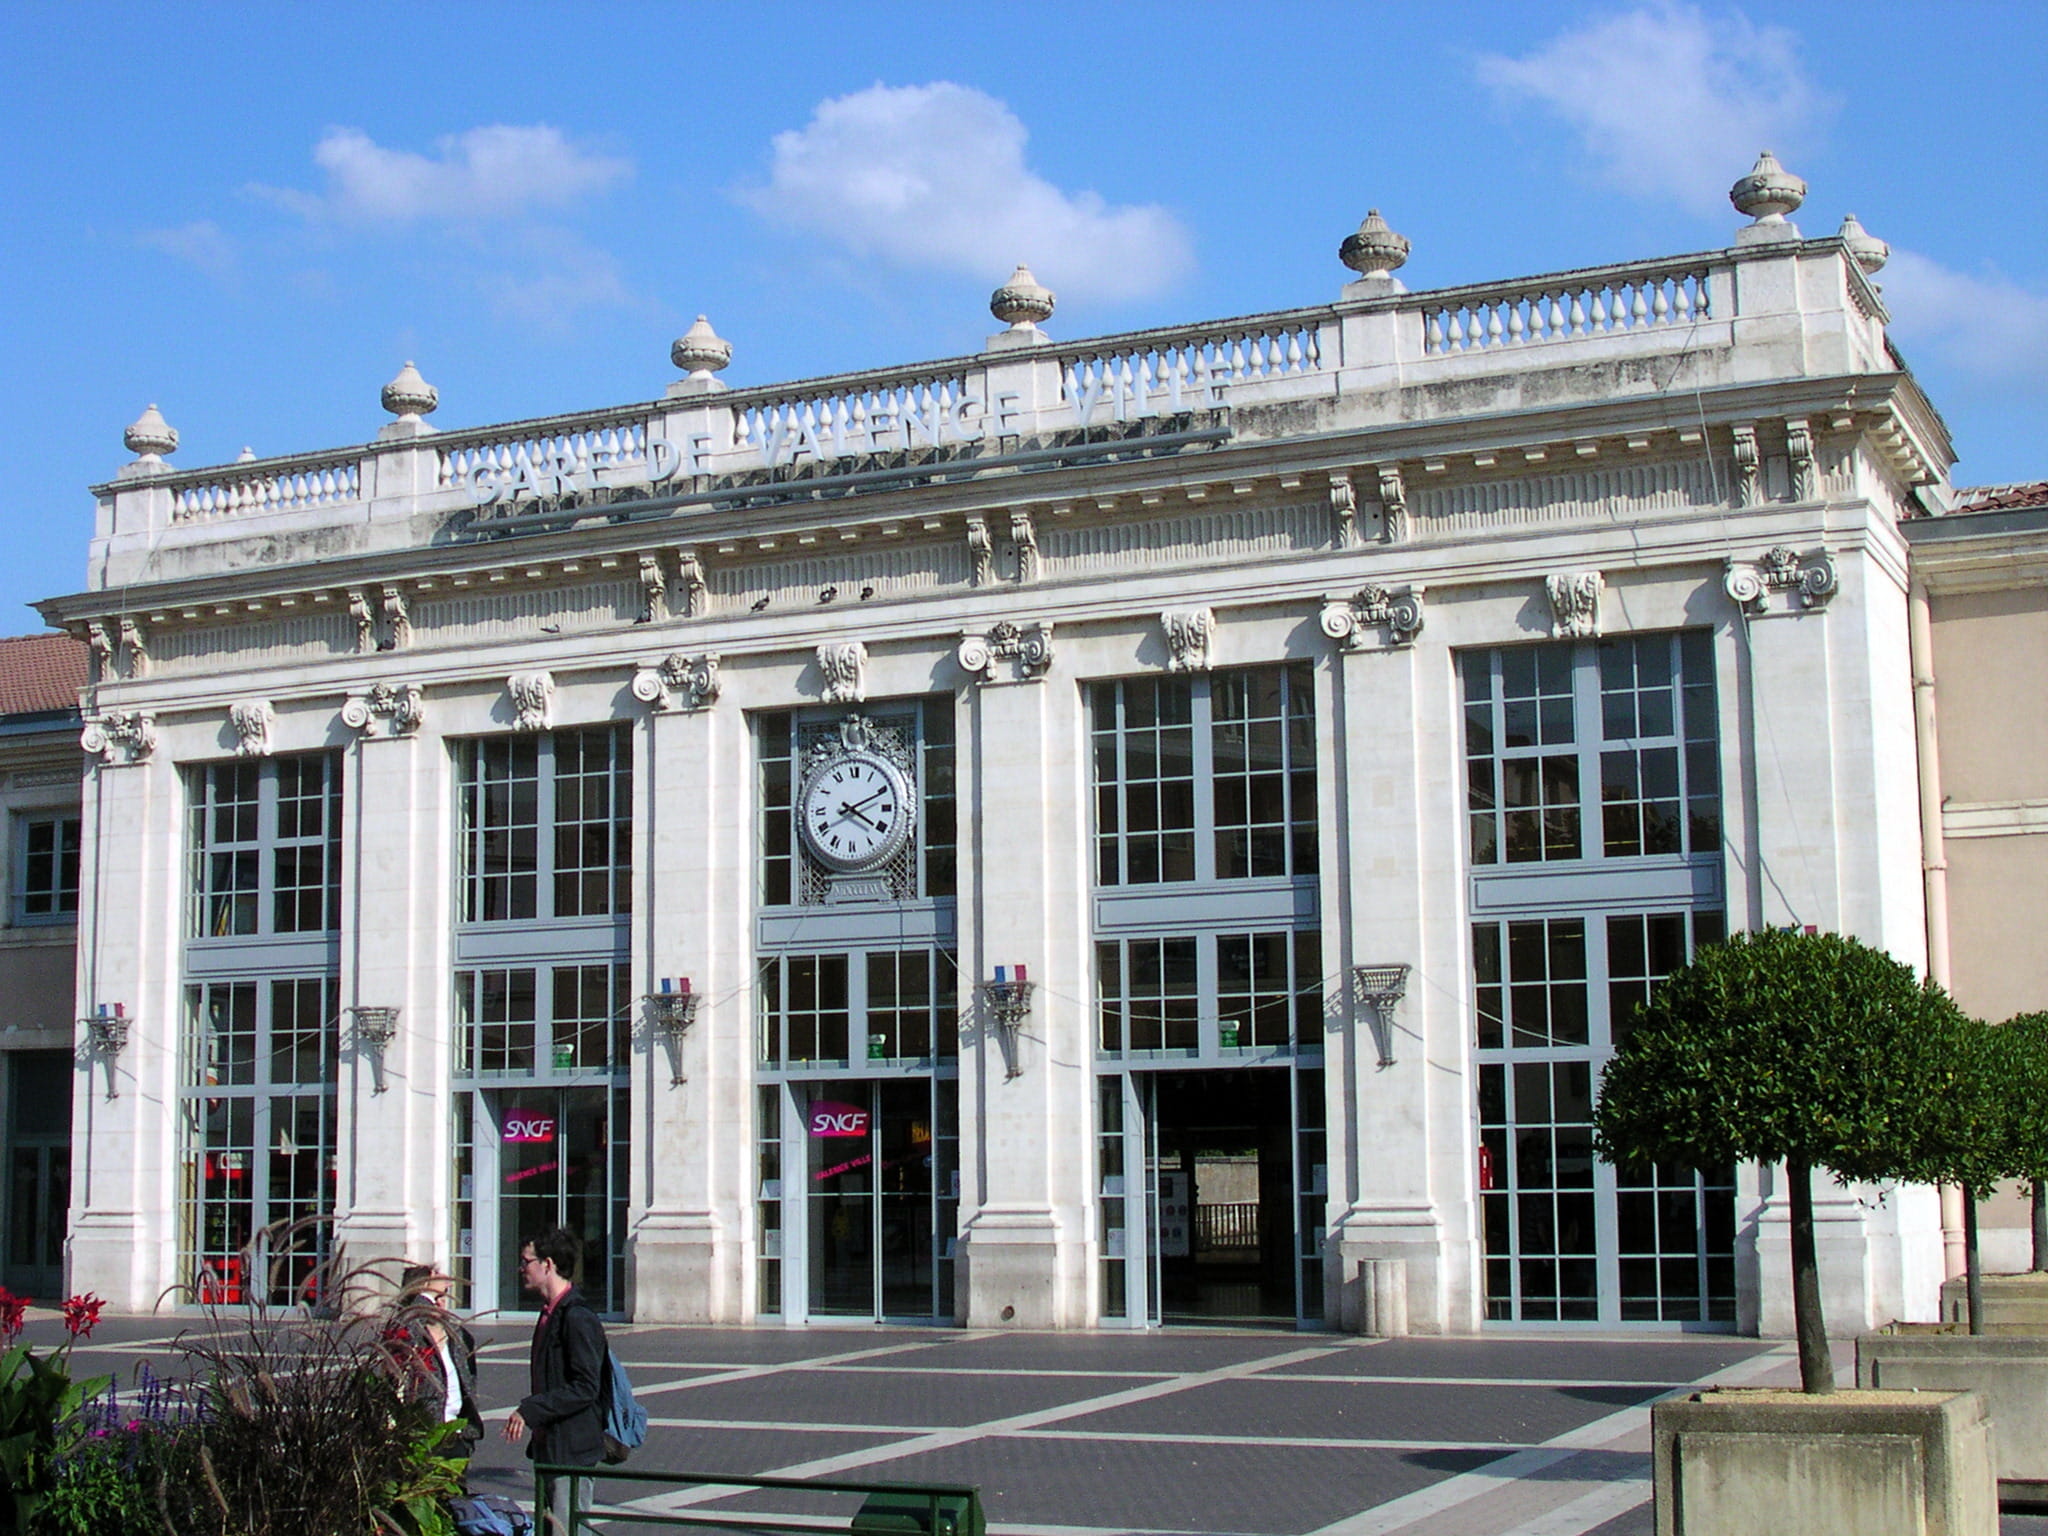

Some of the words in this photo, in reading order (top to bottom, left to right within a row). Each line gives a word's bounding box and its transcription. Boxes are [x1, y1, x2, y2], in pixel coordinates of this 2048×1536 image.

[465, 446, 612, 505] GARE
[647, 431, 713, 483] DE
[750, 391, 1021, 468] VALENCE
[1063, 361, 1233, 428] VILLE
[504, 1119, 554, 1138] SNCF
[812, 1113, 868, 1132] SNCF
